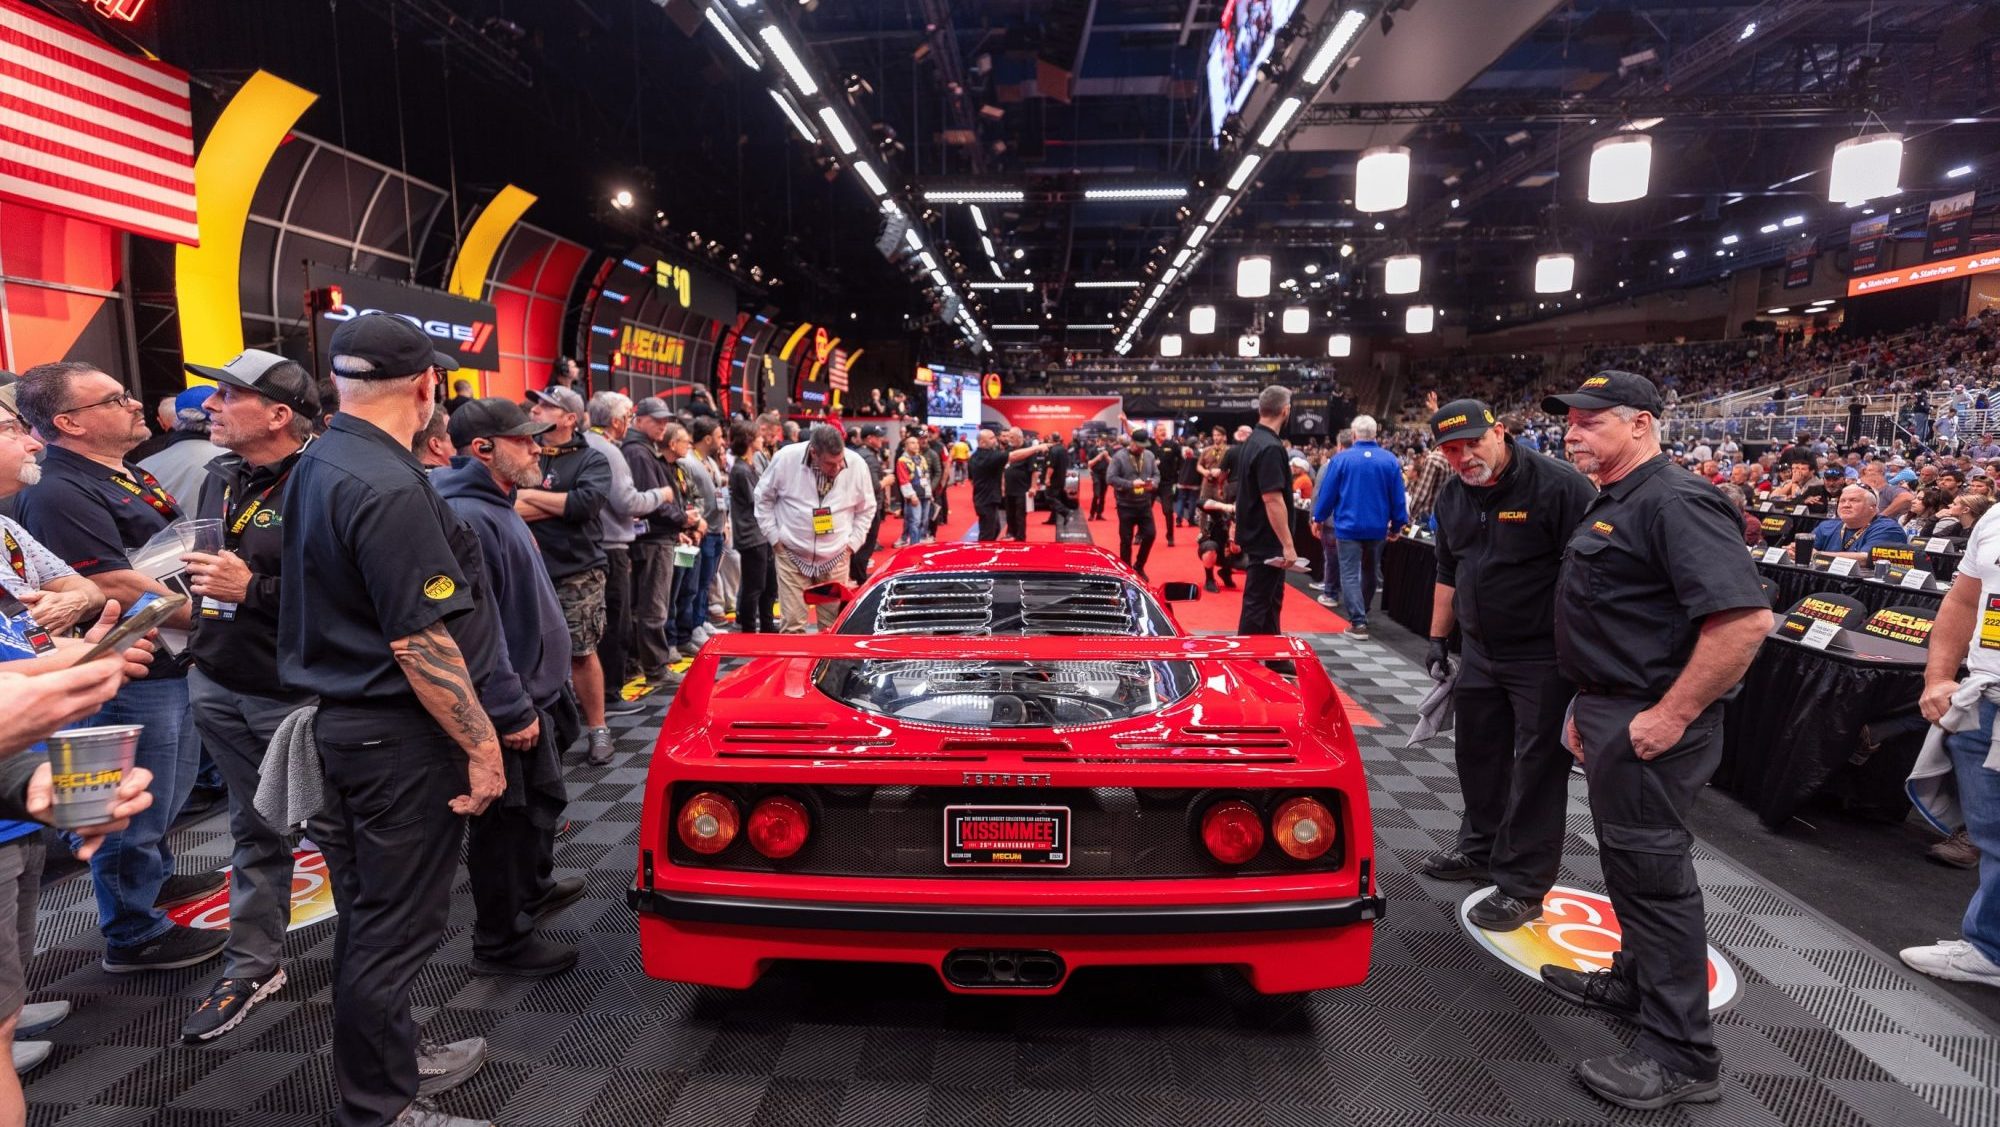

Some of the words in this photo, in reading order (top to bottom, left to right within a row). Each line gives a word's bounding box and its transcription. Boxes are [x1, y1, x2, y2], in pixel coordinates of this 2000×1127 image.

[323, 304, 475, 342] DGE
[230, 500, 260, 534] MECUM
[1871, 546, 1915, 560] MECUM
[1801, 597, 1853, 618] MECUM
[1870, 618, 1928, 638] AUCTIONS
[1874, 609, 1936, 632] MECUM
[1865, 624, 1889, 636] GOLD
[1889, 631, 1924, 644] SEATING
[962, 772, 1052, 786] Ferrari
[962, 822, 1053, 840] KISSIMMEE
[992, 852, 1022, 860] MECUM
